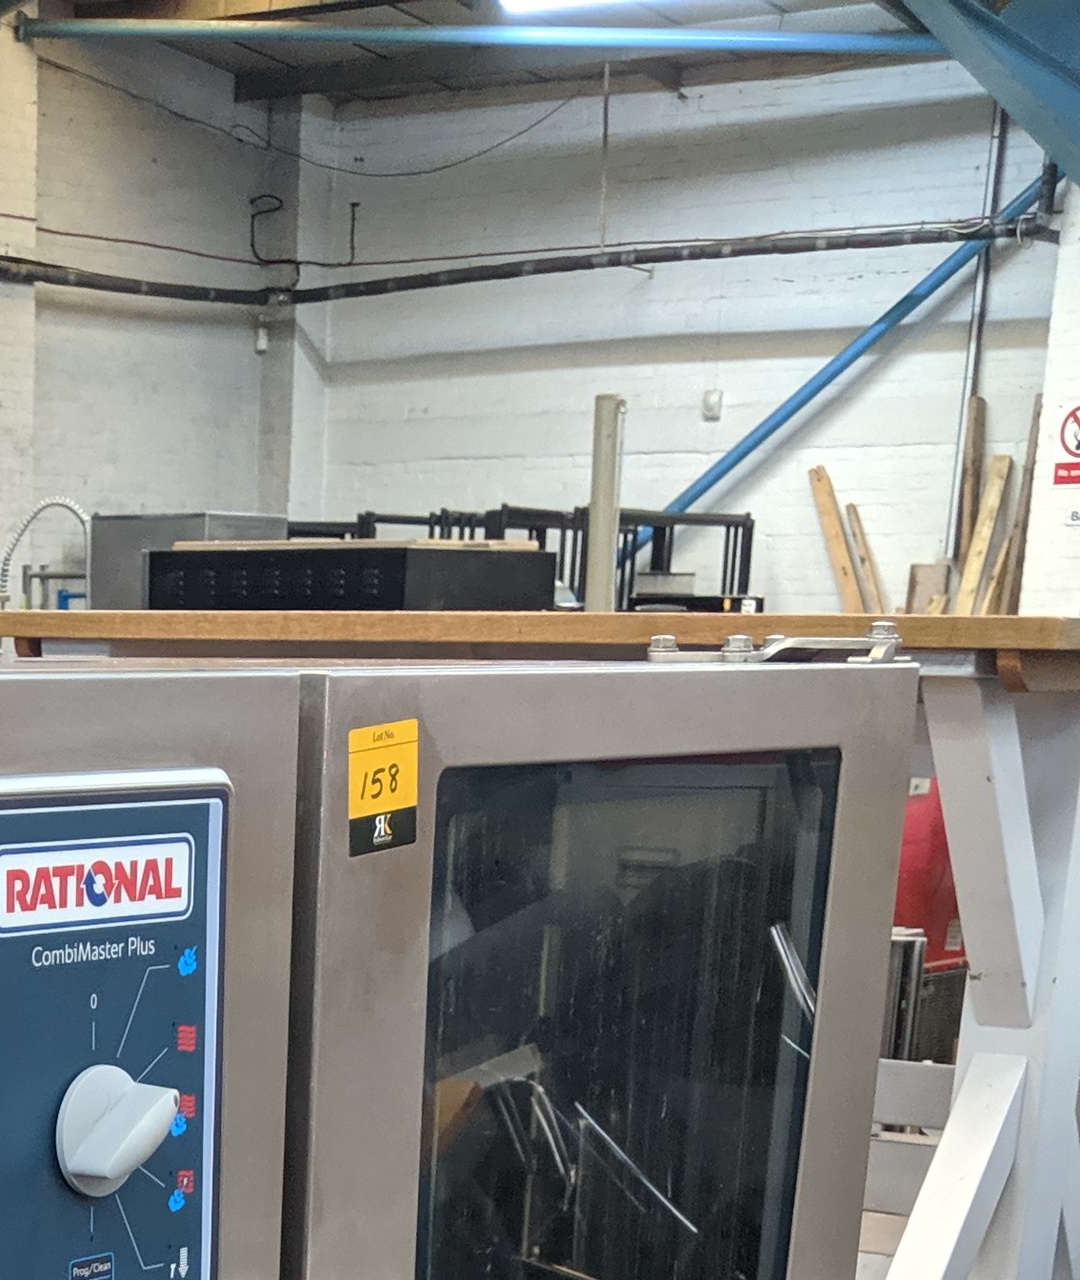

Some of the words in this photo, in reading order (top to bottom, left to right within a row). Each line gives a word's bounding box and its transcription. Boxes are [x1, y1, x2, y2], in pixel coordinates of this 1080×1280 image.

[360, 762, 400, 800] 158
[6, 857, 182, 914] RATIONAL
[31, 941, 124, 968] CombiMaster
[128, 935, 156, 956] Plus
[72, 1261, 112, 1278] Prog/Clean
